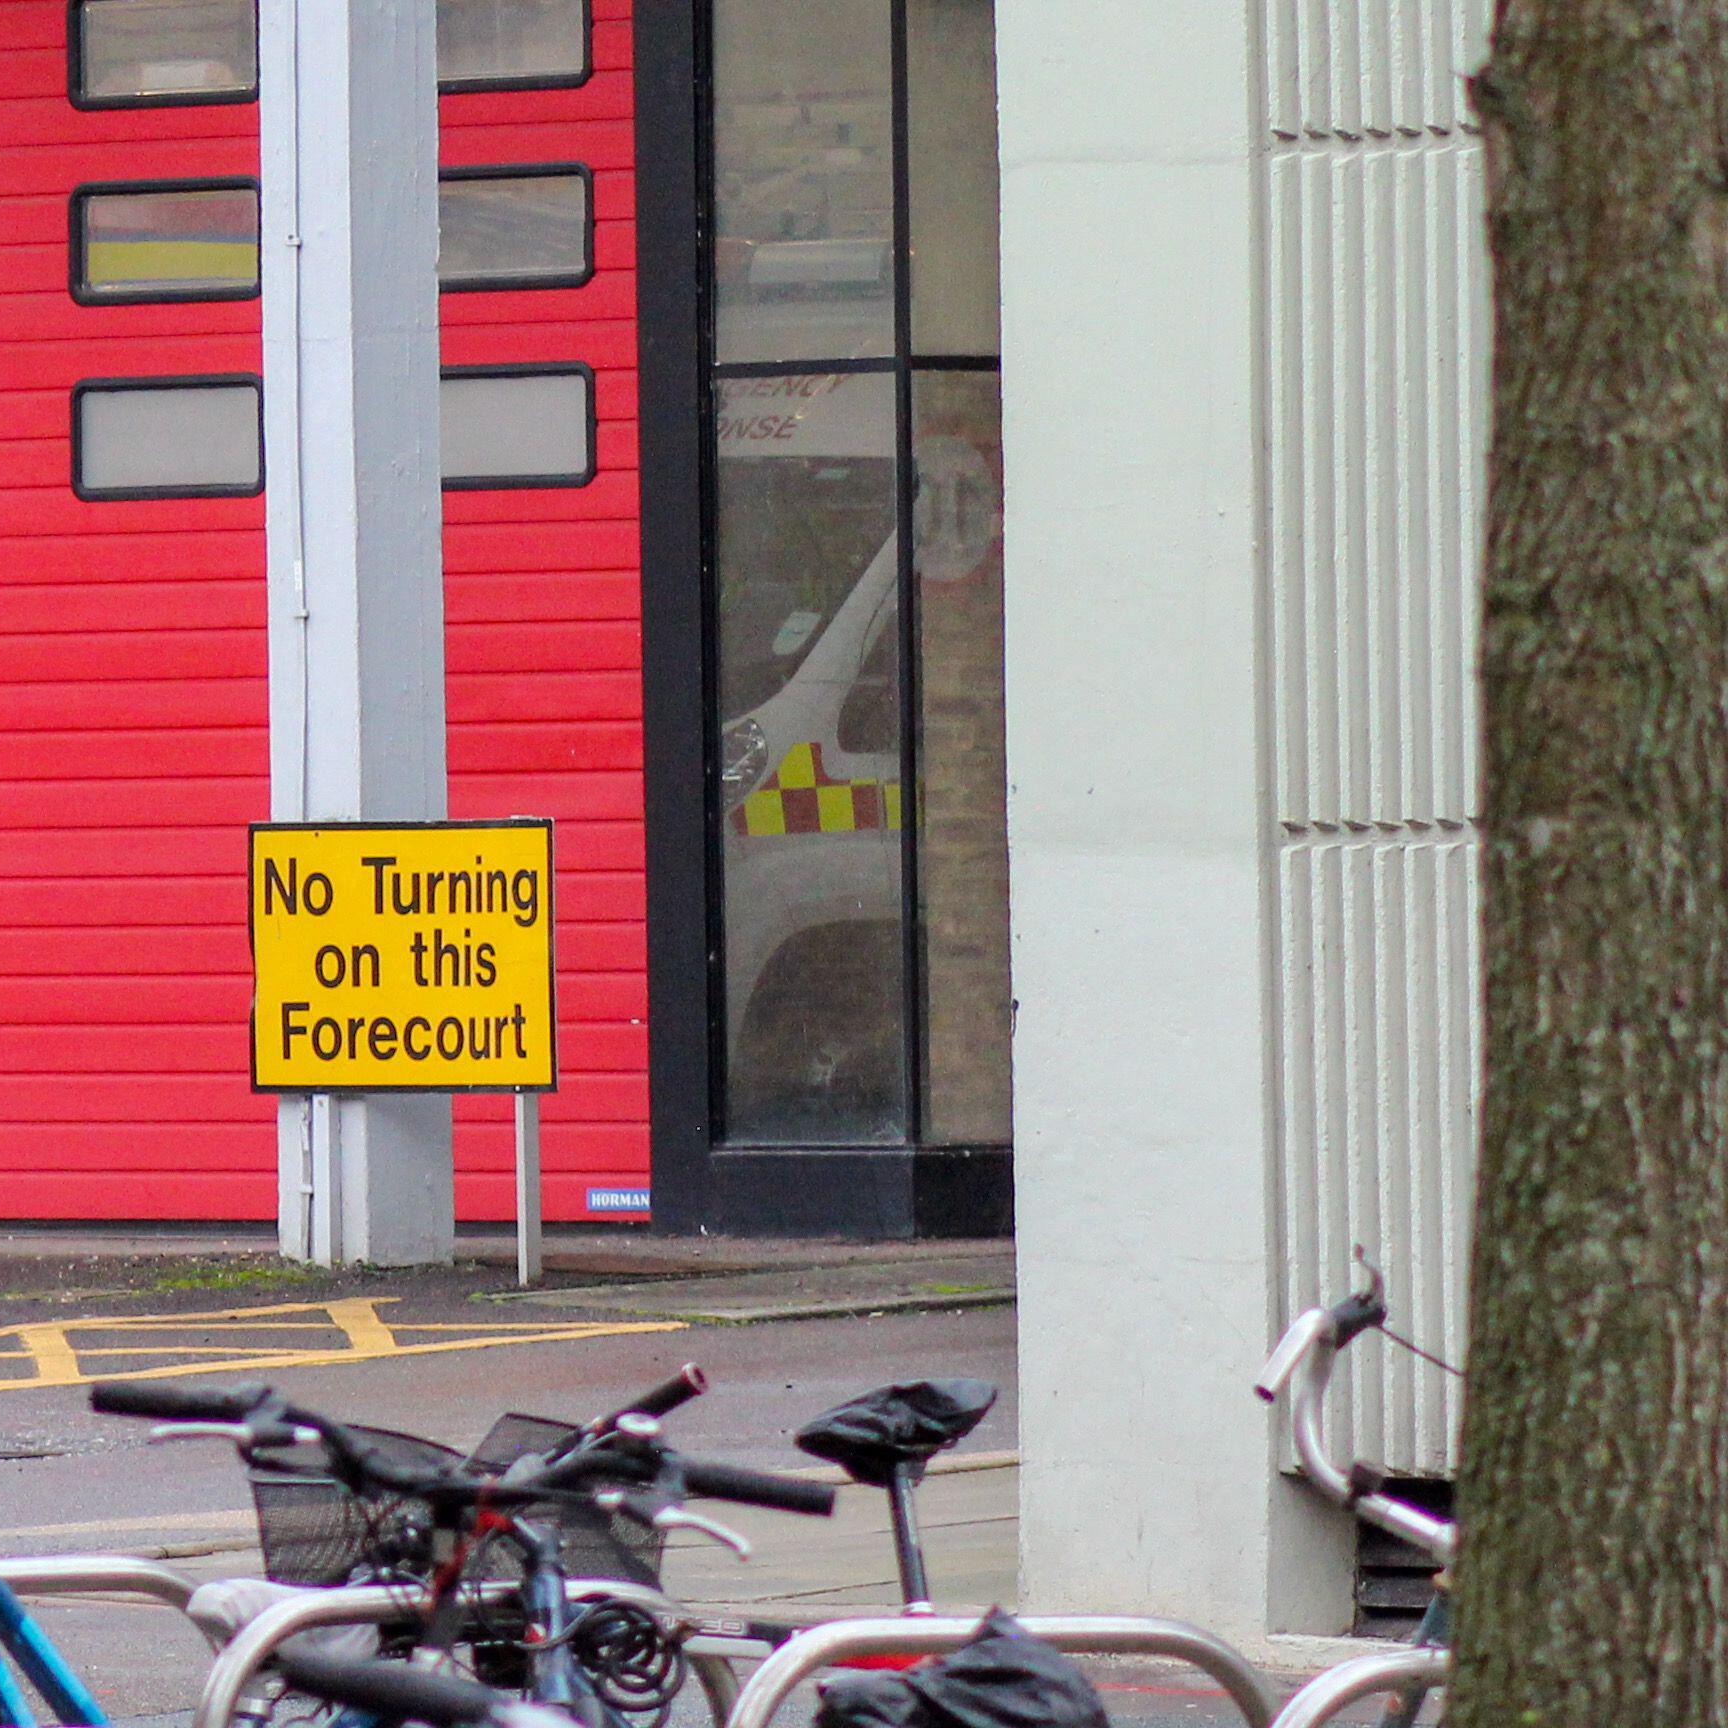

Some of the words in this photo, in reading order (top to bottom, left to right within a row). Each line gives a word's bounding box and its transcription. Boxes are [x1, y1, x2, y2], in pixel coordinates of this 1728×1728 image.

[263, 857, 334, 916] No
[361, 855, 539, 928] Turning
[314, 943, 380, 989] on
[410, 928, 497, 988] this
[281, 1002, 527, 1062] Forecourt
